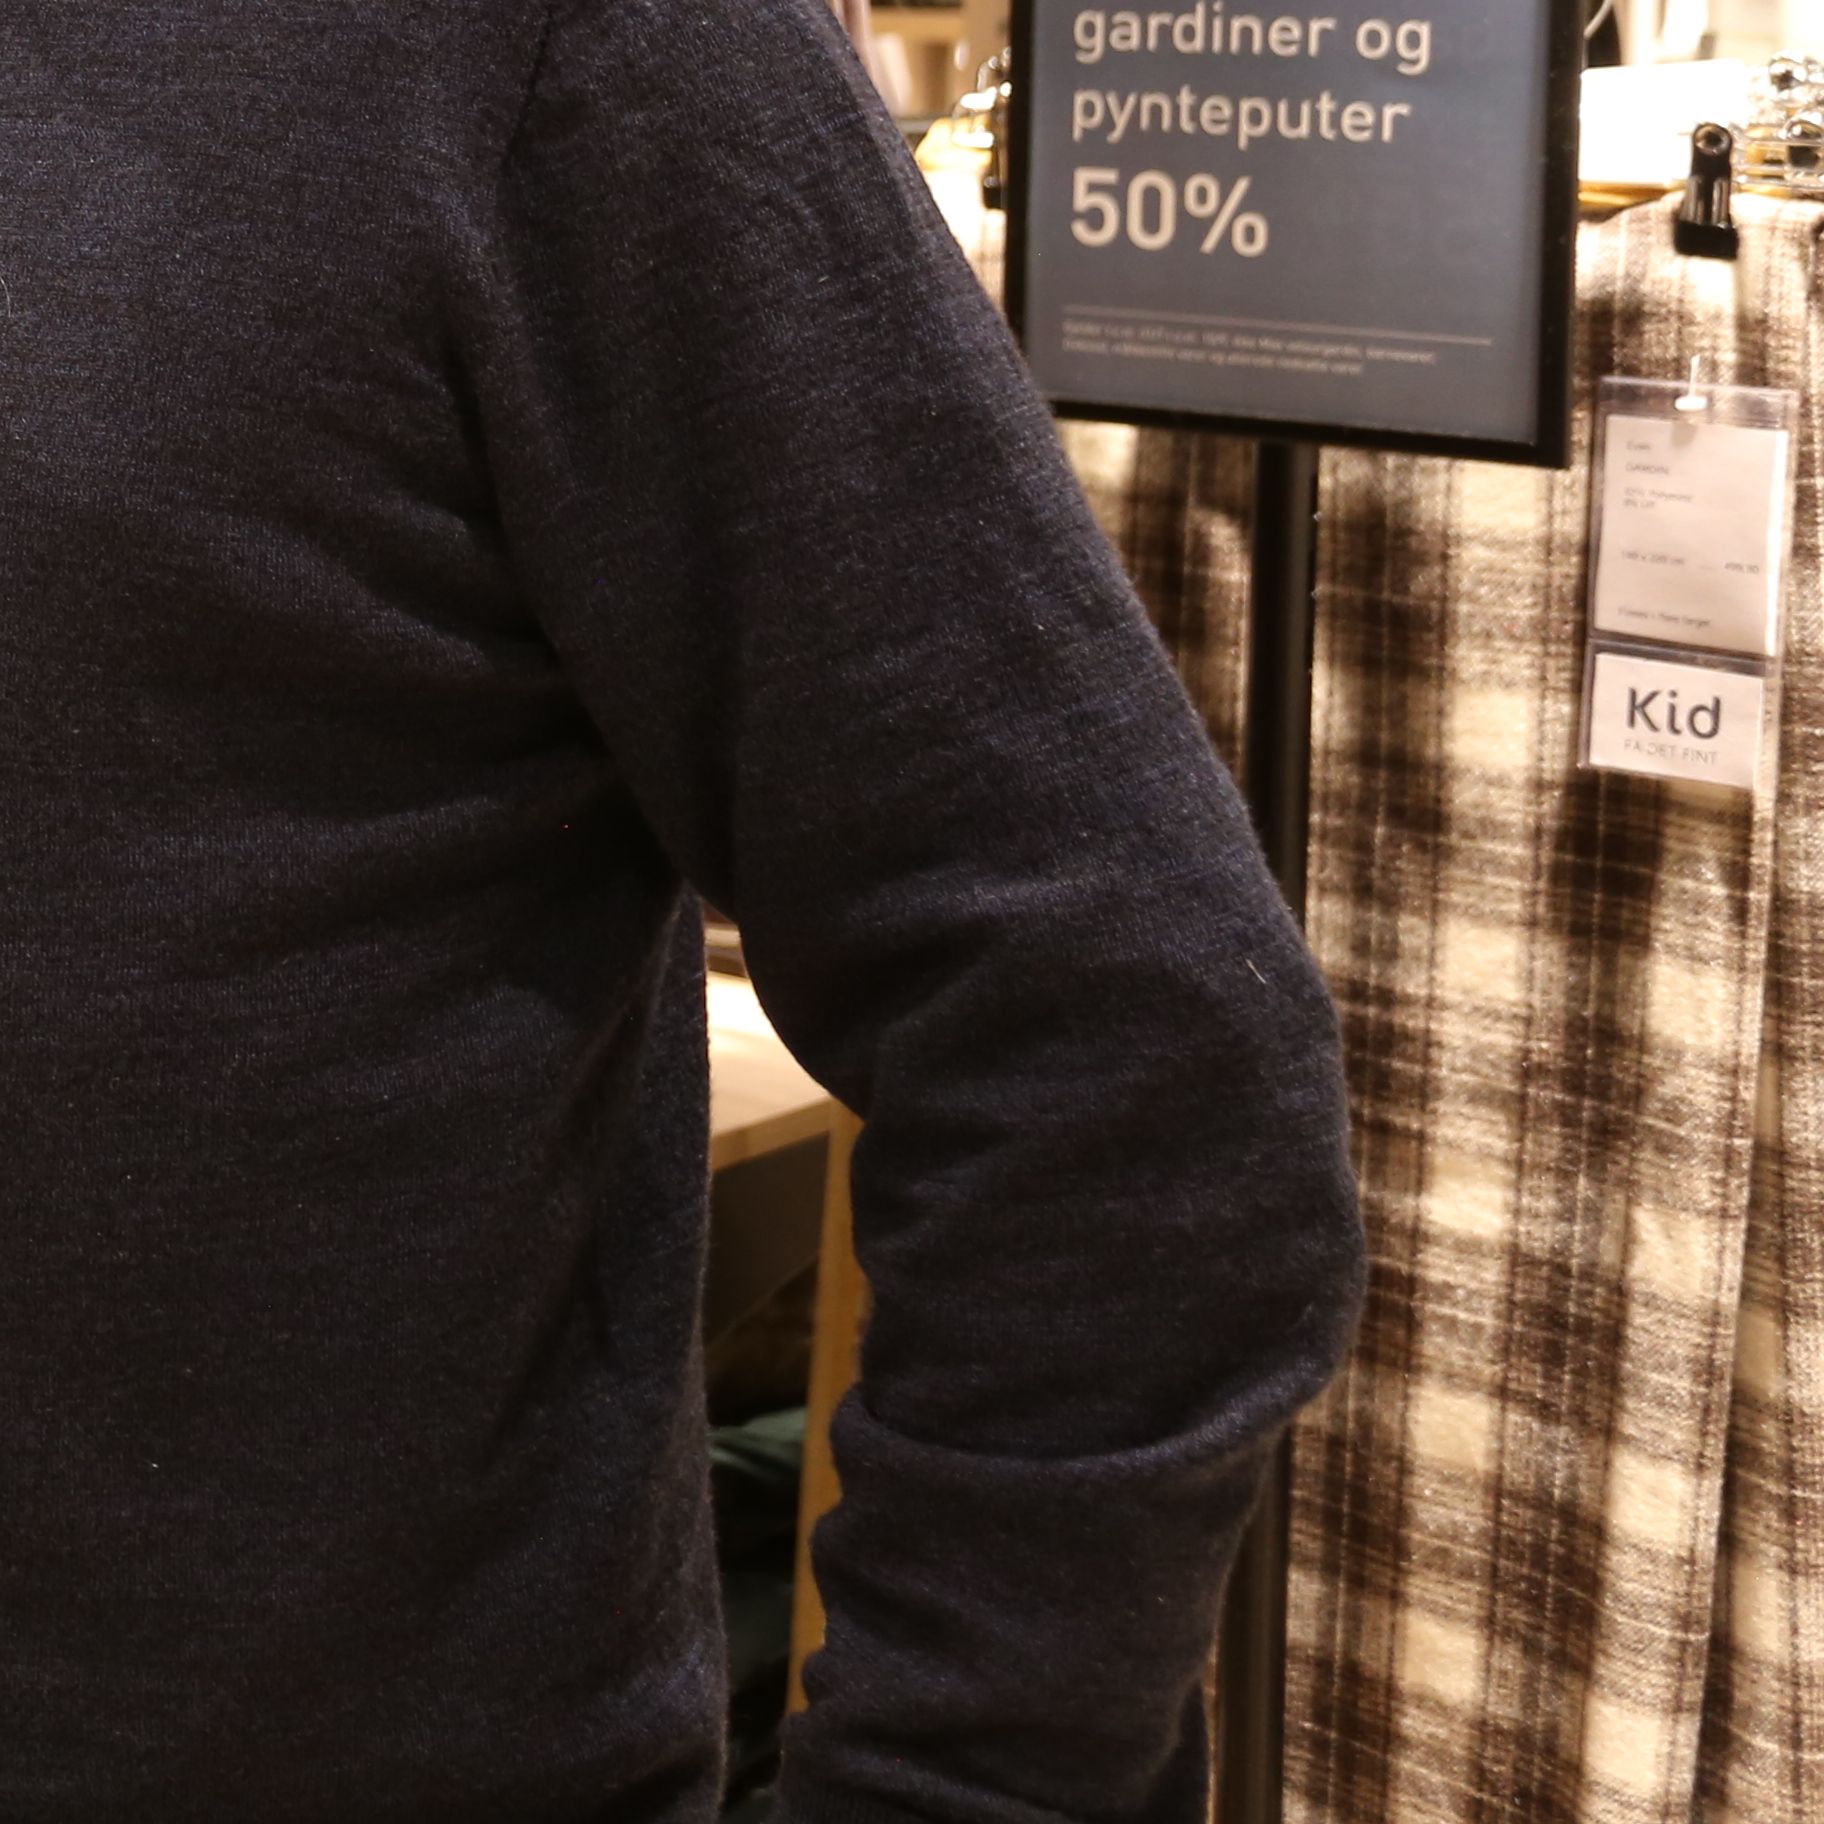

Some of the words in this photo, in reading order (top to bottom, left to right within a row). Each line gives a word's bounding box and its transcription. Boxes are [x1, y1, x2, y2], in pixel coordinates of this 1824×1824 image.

[1073, 0, 1336, 64] gardiner
[1355, 18, 1432, 75] og
[1071, 86, 1412, 150] pynteputer
[1070, 167, 1269, 258] 50%
[1627, 687, 1721, 740] Kid
